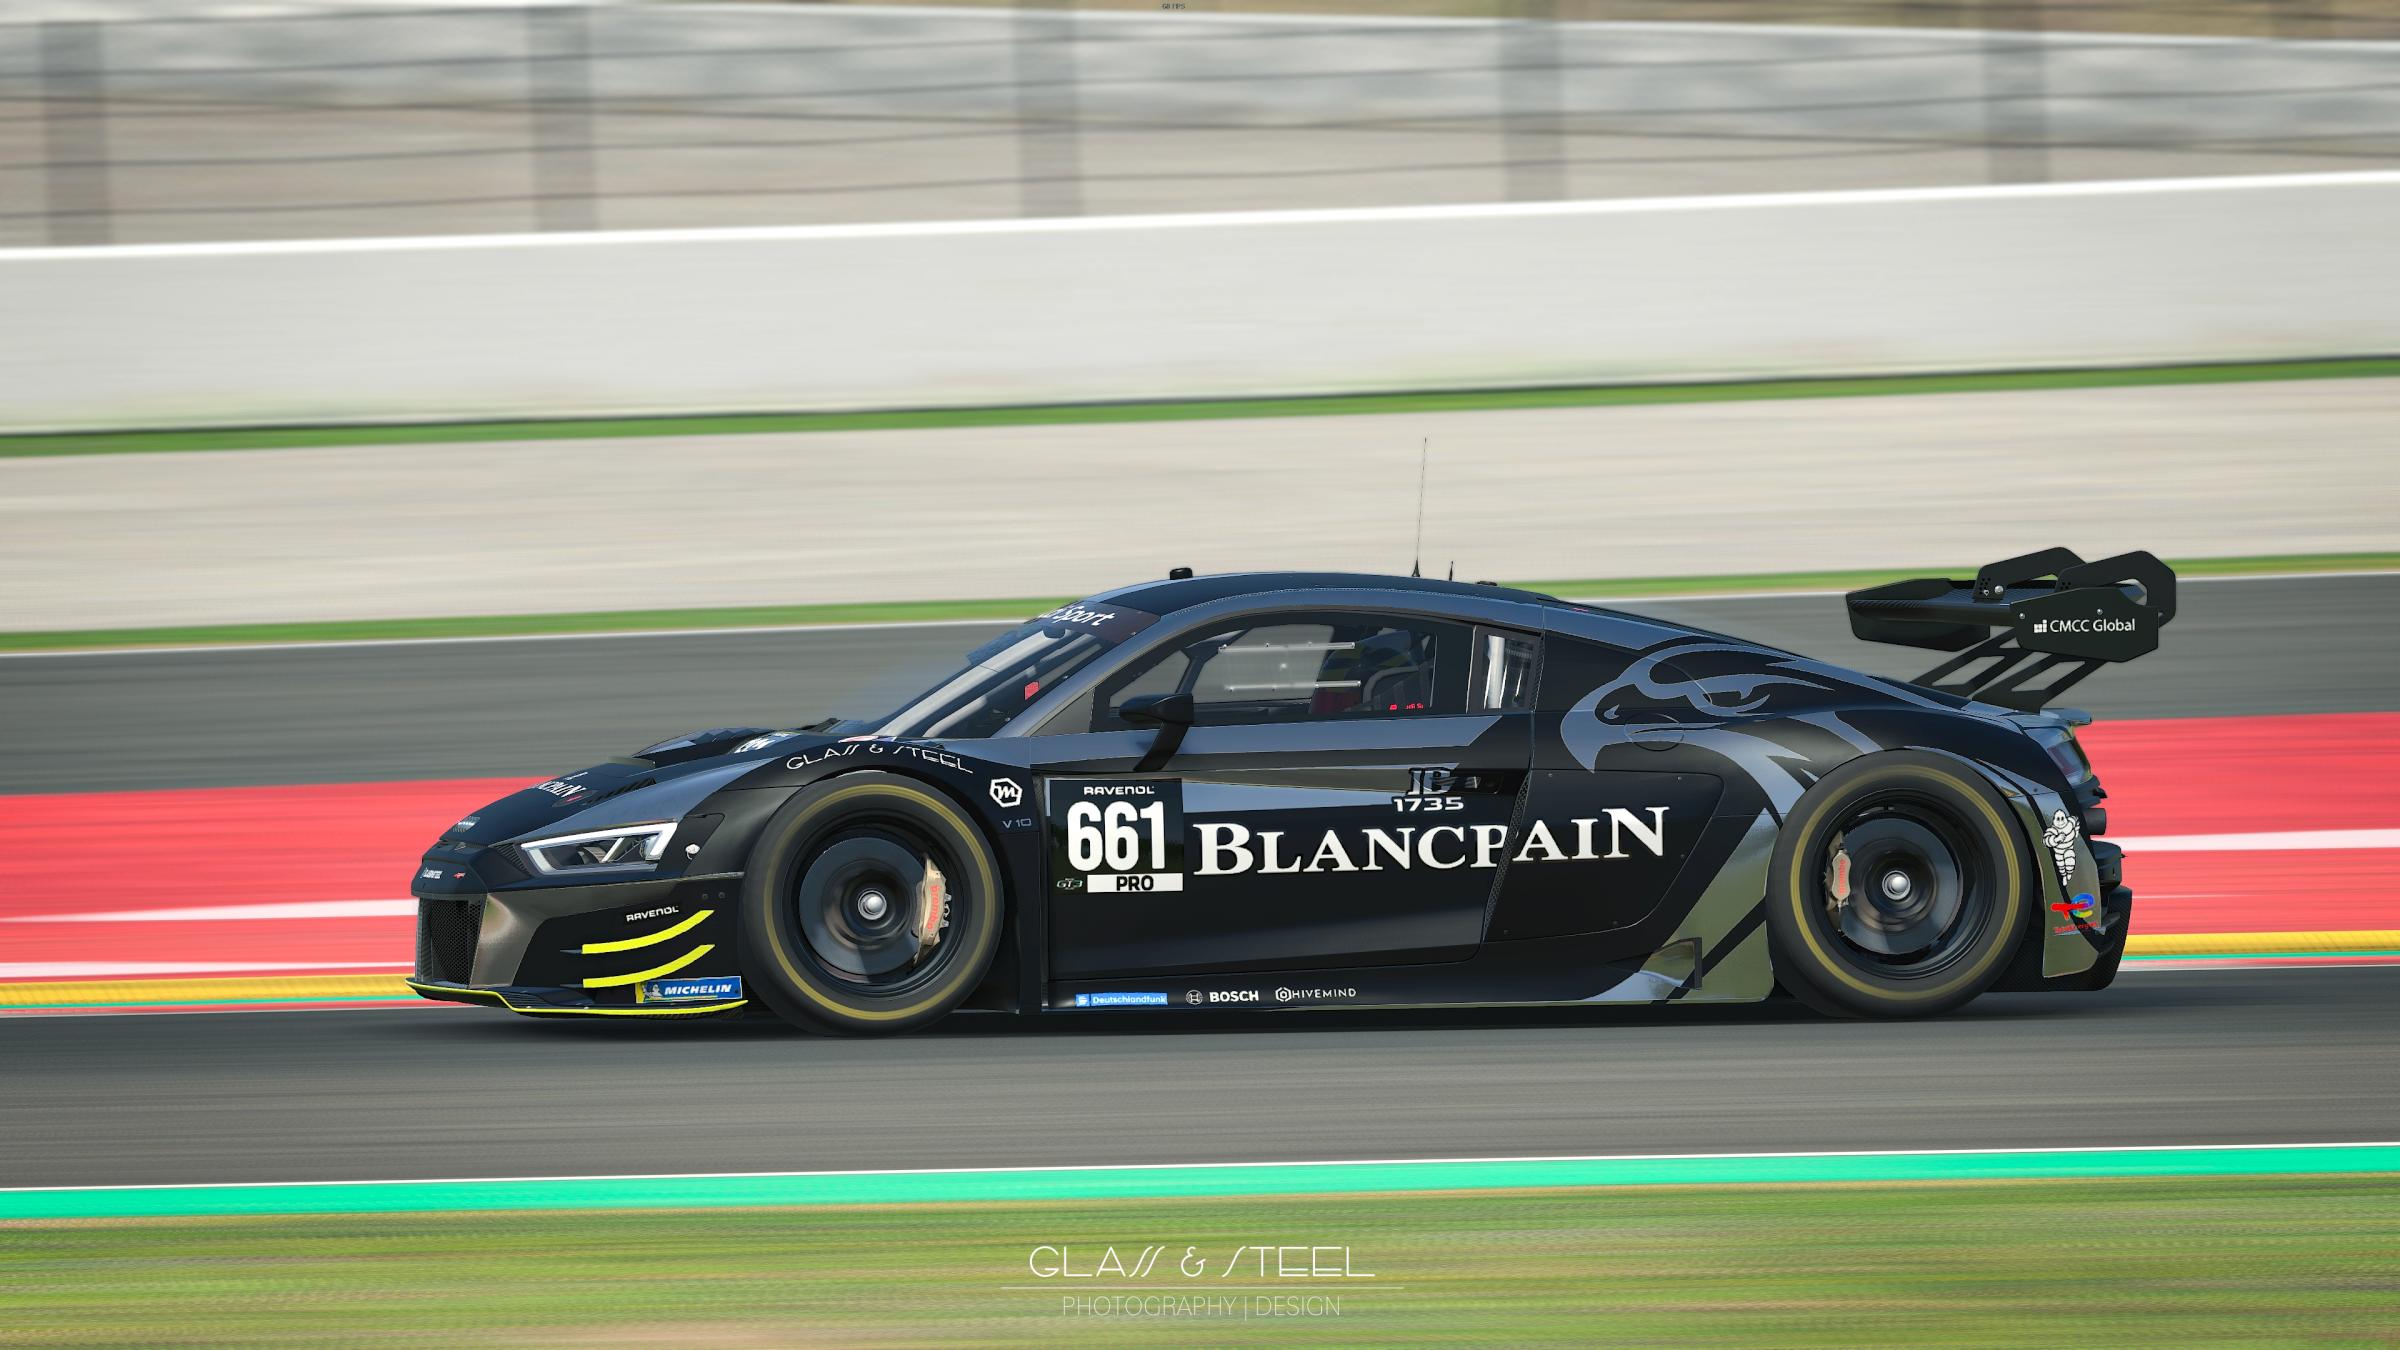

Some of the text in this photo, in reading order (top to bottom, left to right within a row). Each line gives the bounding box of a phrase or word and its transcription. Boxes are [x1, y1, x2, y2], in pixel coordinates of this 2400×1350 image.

[1052, 605, 1115, 626] Sport
[2049, 618, 2136, 633] CMCC Global
[786, 744, 973, 774] GLASS & STEEL
[1083, 785, 1155, 796] RAVENOL
[1393, 796, 1464, 812] 1735
[1003, 818, 1032, 829] V 10
[1067, 800, 1165, 872] 661
[1193, 806, 1670, 876] BLANCPAIN
[1116, 875, 1154, 891] PRO
[626, 906, 679, 922] RAVENOL
[664, 984, 732, 995] MICHELIN
[1209, 990, 1260, 1003] BOSCH
[1291, 988, 1357, 999] HIVEMIND
[1092, 995, 1167, 1004] Deutschlandfunk
